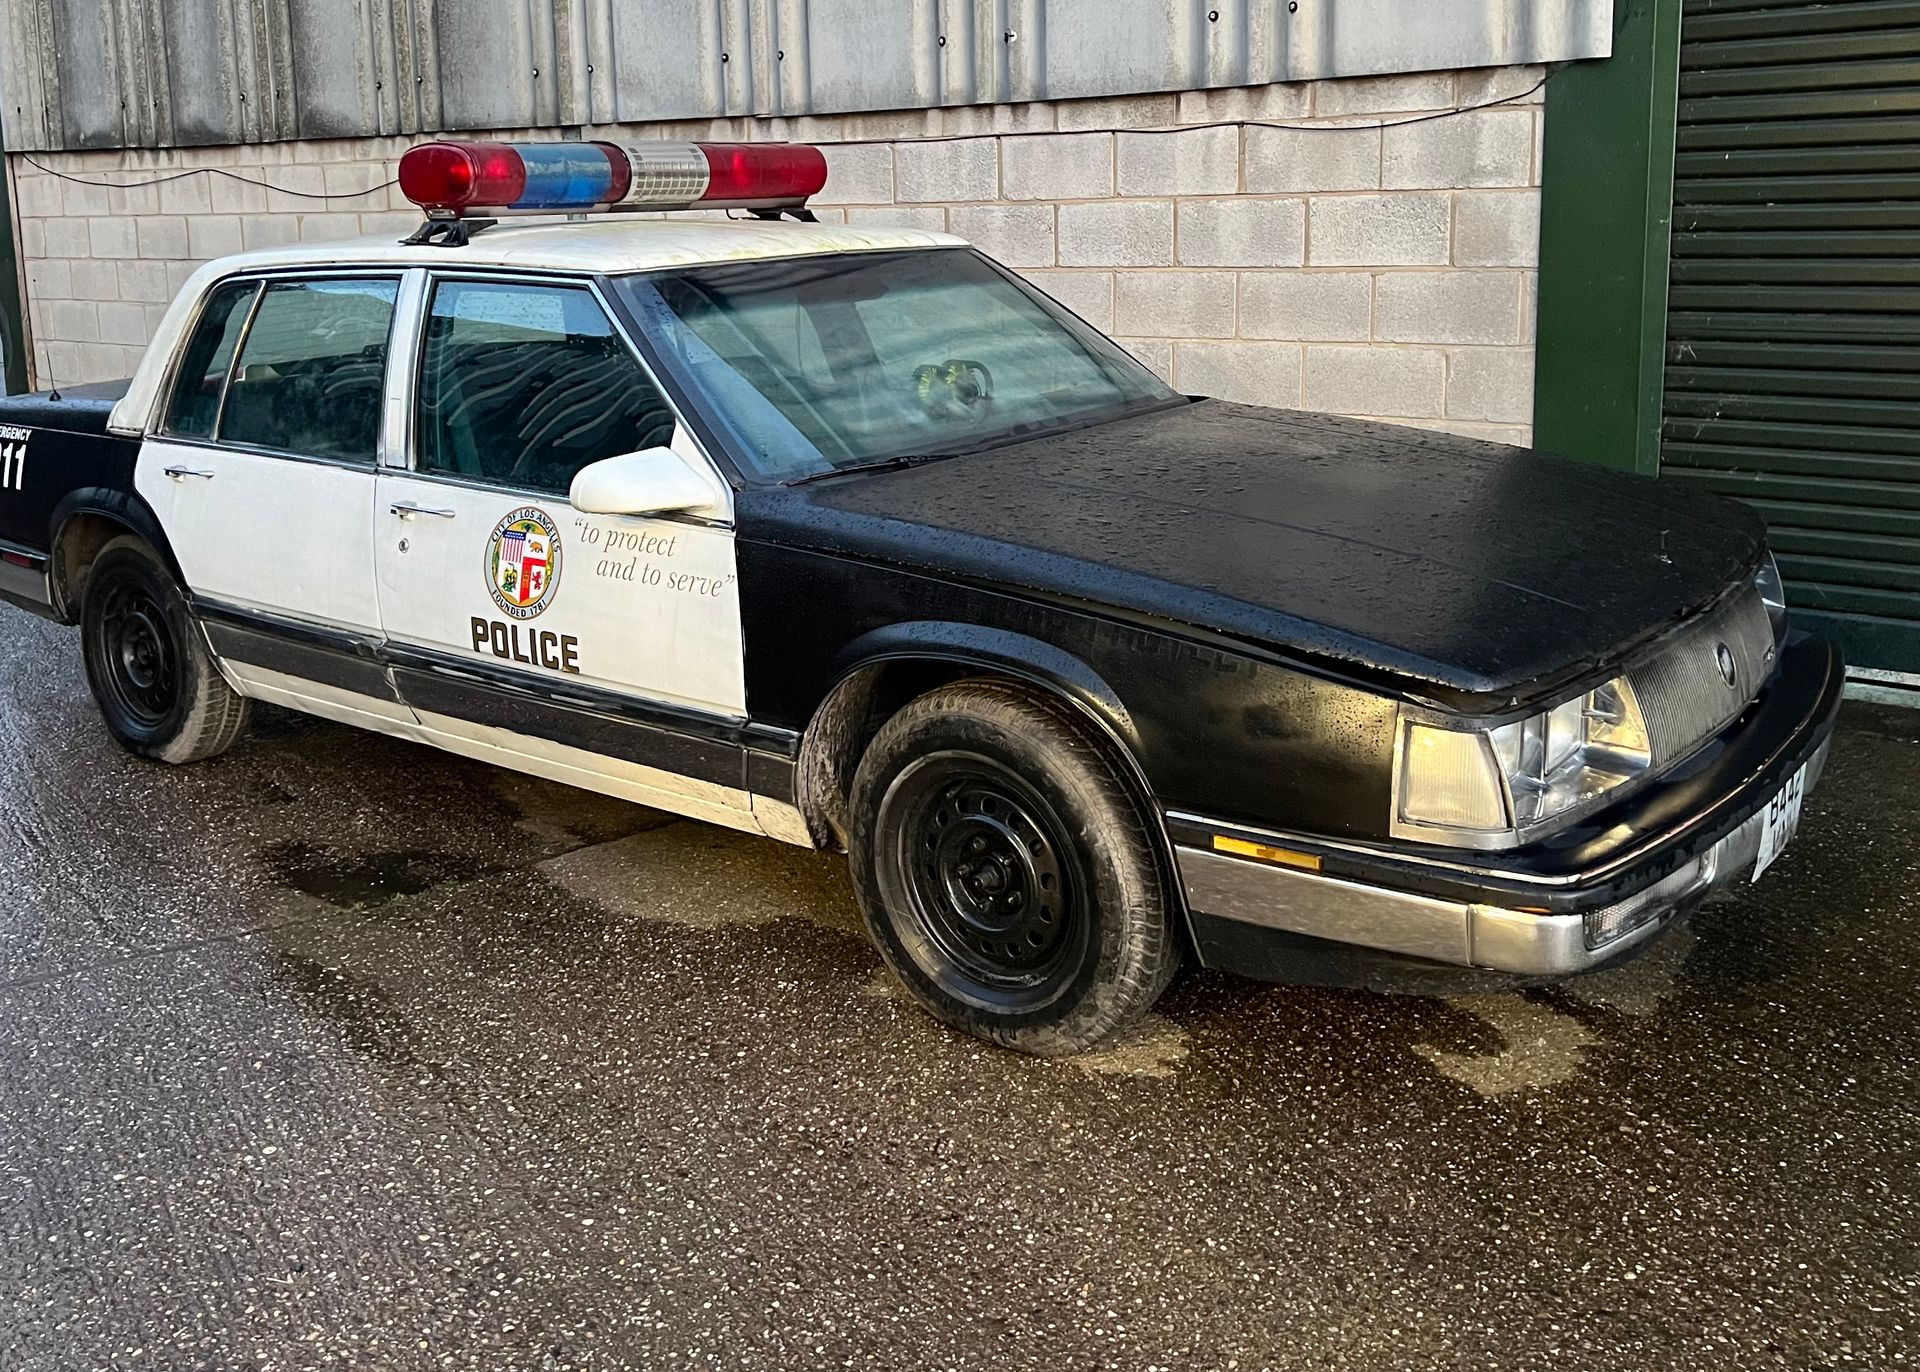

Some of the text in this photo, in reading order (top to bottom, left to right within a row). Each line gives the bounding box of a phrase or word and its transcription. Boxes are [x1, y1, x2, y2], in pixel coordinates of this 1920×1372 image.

[0, 442, 26, 490] 11
[491, 509, 561, 553] CITY OF LOS ANGELES
[603, 527, 677, 558] protect
[596, 556, 637, 583] and
[642, 562, 661, 586] to
[491, 588, 547, 617] FOUNDED 1781
[470, 616, 580, 675] POLICE
